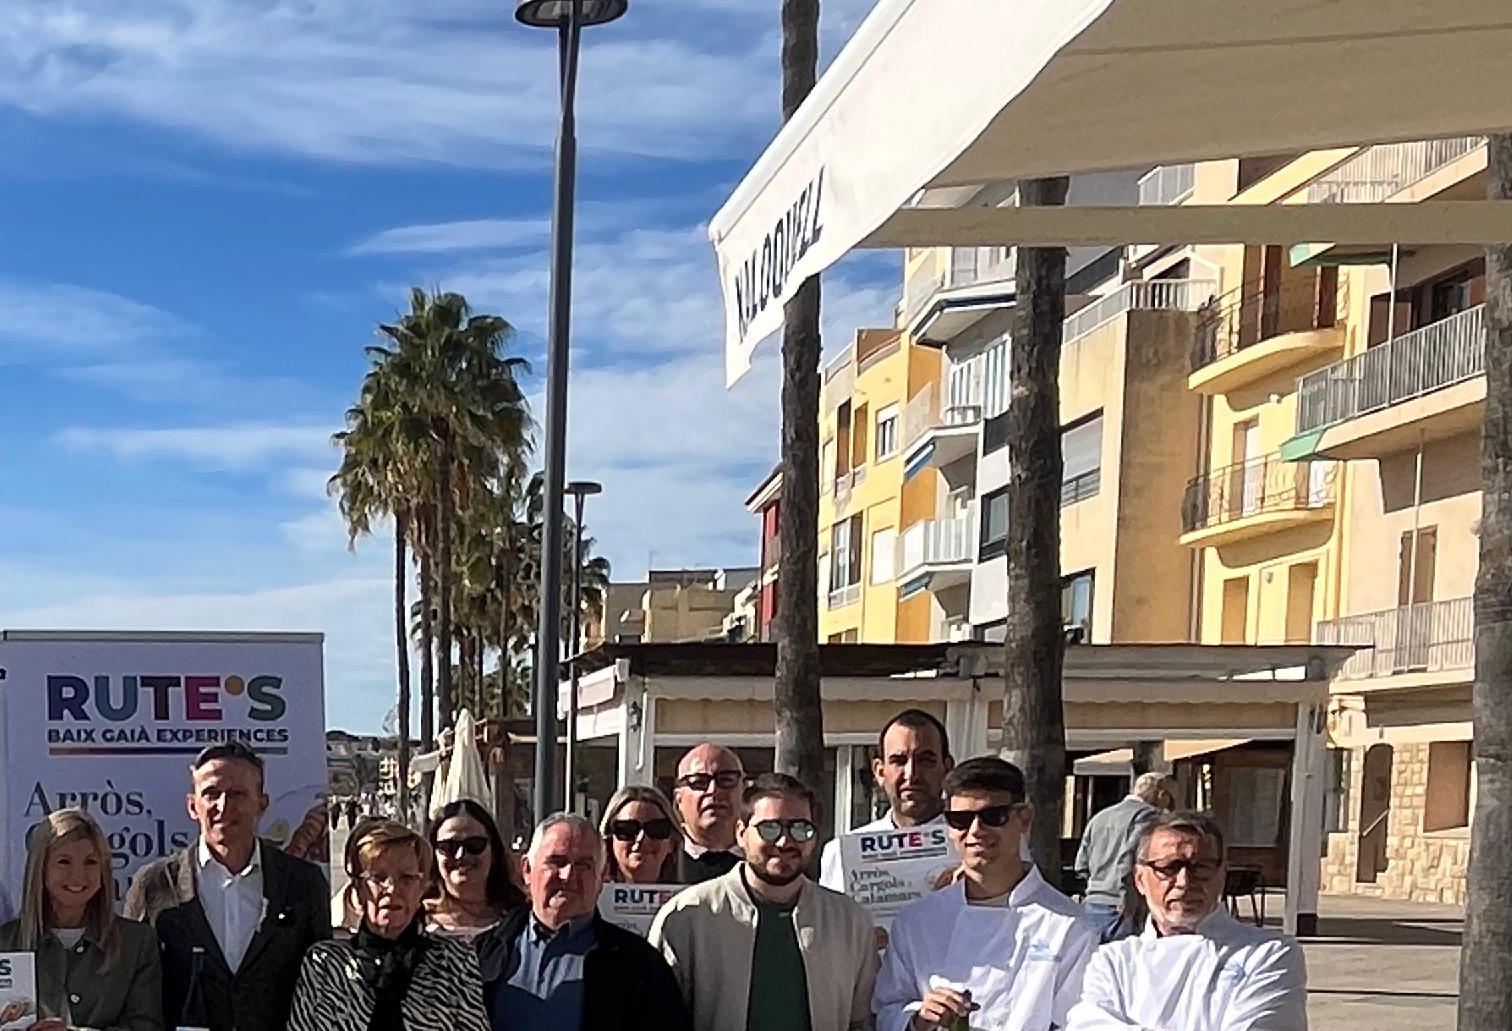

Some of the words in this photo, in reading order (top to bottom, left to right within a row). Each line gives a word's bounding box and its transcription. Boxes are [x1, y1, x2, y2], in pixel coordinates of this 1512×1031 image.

[48, 729, 95, 743] BAIX
[102, 725, 150, 743] GAIÀ
[156, 729, 288, 744] EXPERIENCES
[24, 779, 153, 817] Arròs,
[614, 889, 672, 904] RUTE
